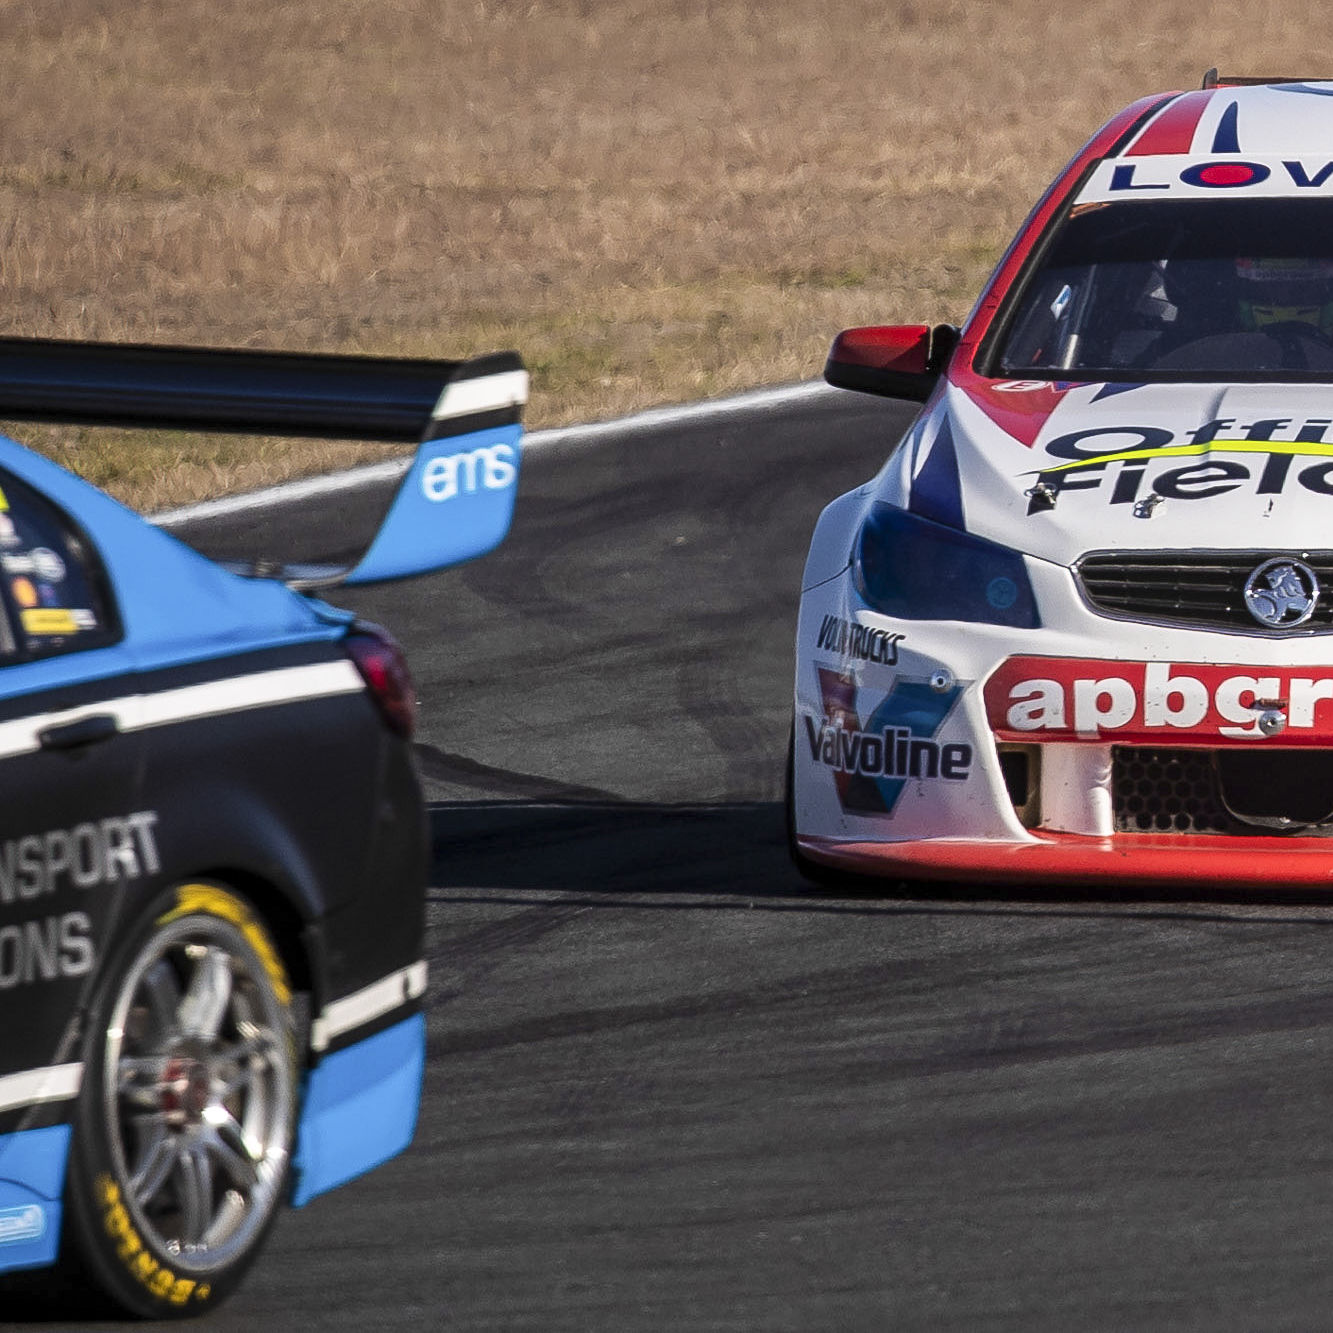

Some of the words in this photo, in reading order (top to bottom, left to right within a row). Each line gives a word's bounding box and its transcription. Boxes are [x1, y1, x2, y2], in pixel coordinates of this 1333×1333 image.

[850, 622, 905, 666] TRUCKS
[806, 716, 972, 781] Valvoline
[0, 911, 94, 987] ONS
